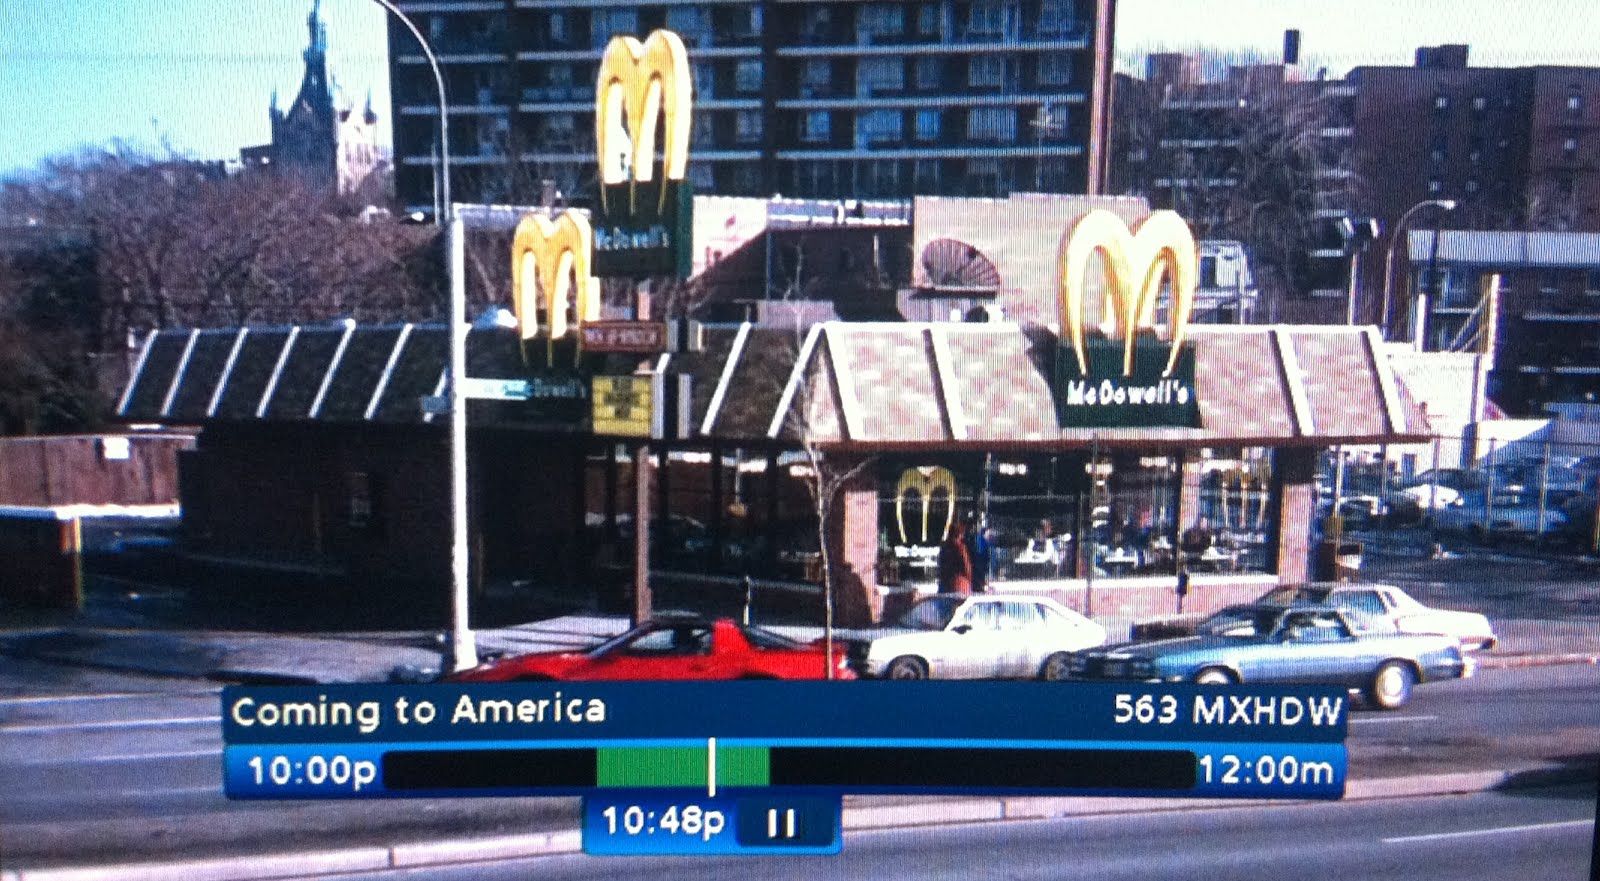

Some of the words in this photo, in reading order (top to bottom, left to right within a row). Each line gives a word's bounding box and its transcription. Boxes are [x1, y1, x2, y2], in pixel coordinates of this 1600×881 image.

[1067, 379, 1189, 405] McDowell's
[232, 694, 381, 734] Coming
[395, 697, 437, 725] to
[451, 692, 607, 725] America
[1114, 693, 1178, 725] 563
[1192, 695, 1344, 726] MXHDW
[247, 754, 378, 792] 10:00p
[1199, 753, 1334, 785] 12:00m
[602, 804, 725, 842] 10:48p
